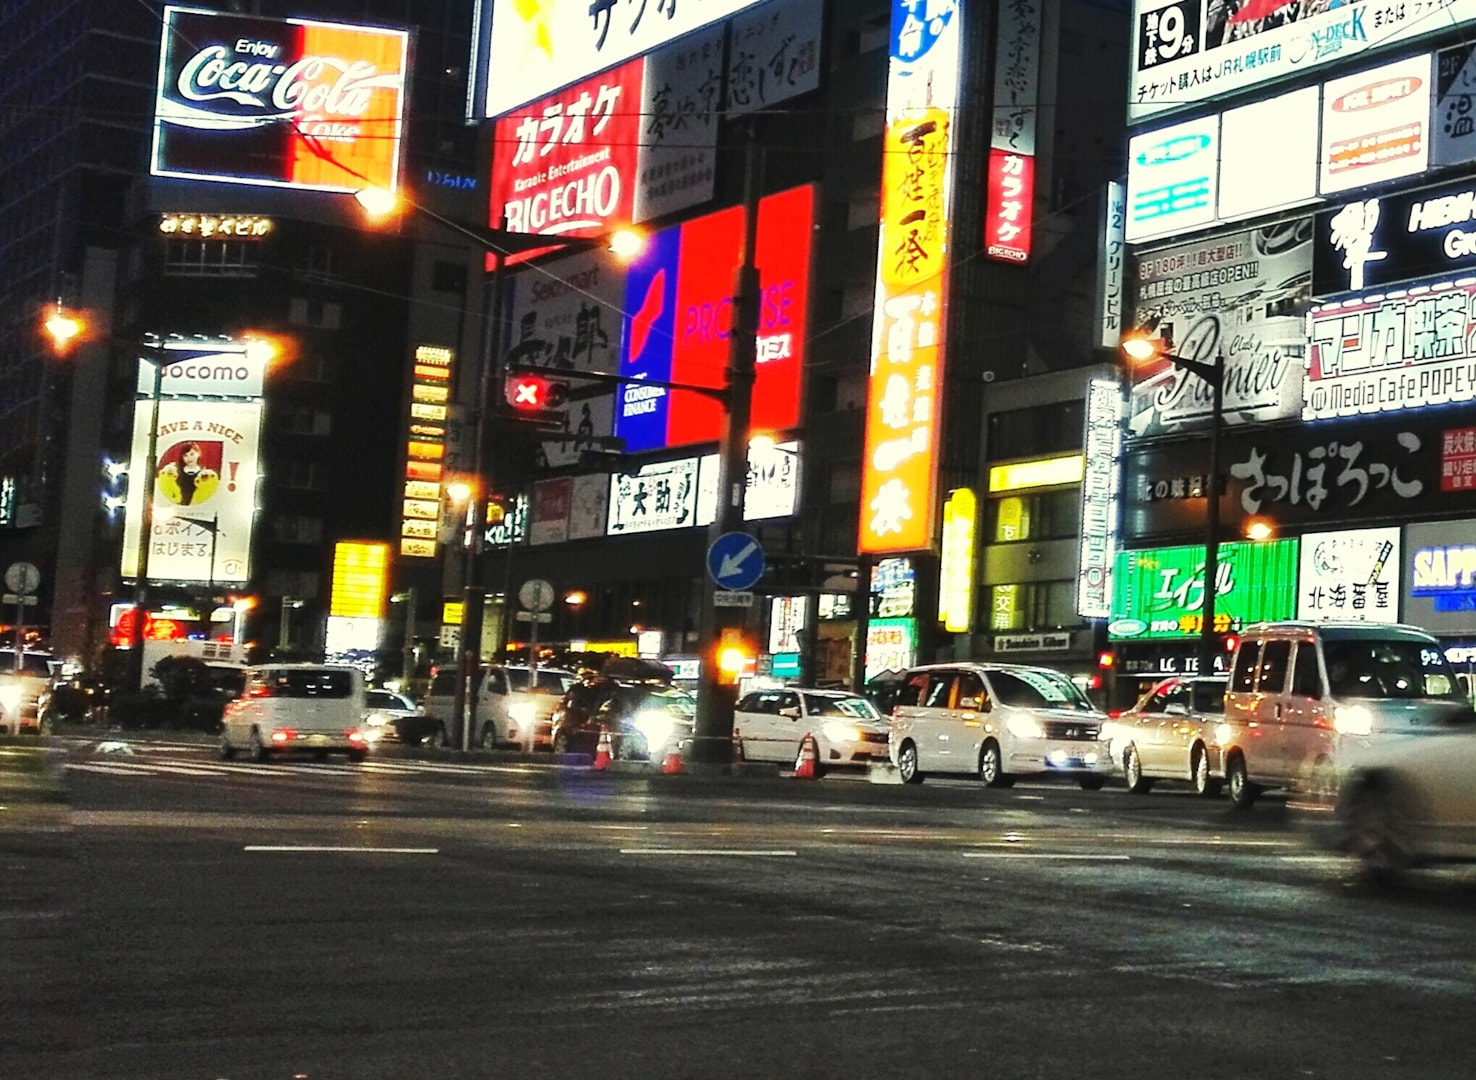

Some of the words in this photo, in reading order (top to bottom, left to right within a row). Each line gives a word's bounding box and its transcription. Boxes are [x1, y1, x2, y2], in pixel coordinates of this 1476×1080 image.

[1374, 3, 1406, 29] または
[235, 37, 278, 59] Enjoy
[178, 45, 376, 117] Coca-Cola
[512, 85, 622, 167] カラオケ
[514, 172, 547, 193] Karaoke
[547, 147, 611, 182] Entertainment
[996, 155, 1023, 243] カラオケ
[1105, 240, 1123, 330] グリーンビル
[623, 399, 657, 418] FINANCE
[1330, 379, 1375, 410] Media
[1378, 374, 1416, 403] Cafe
[208, 422, 245, 445] NICE
[1230, 432, 1424, 515] さっぽろっこ
[152, 541, 213, 558] はじまる。
[1308, 581, 1390, 610] 北海番屋
